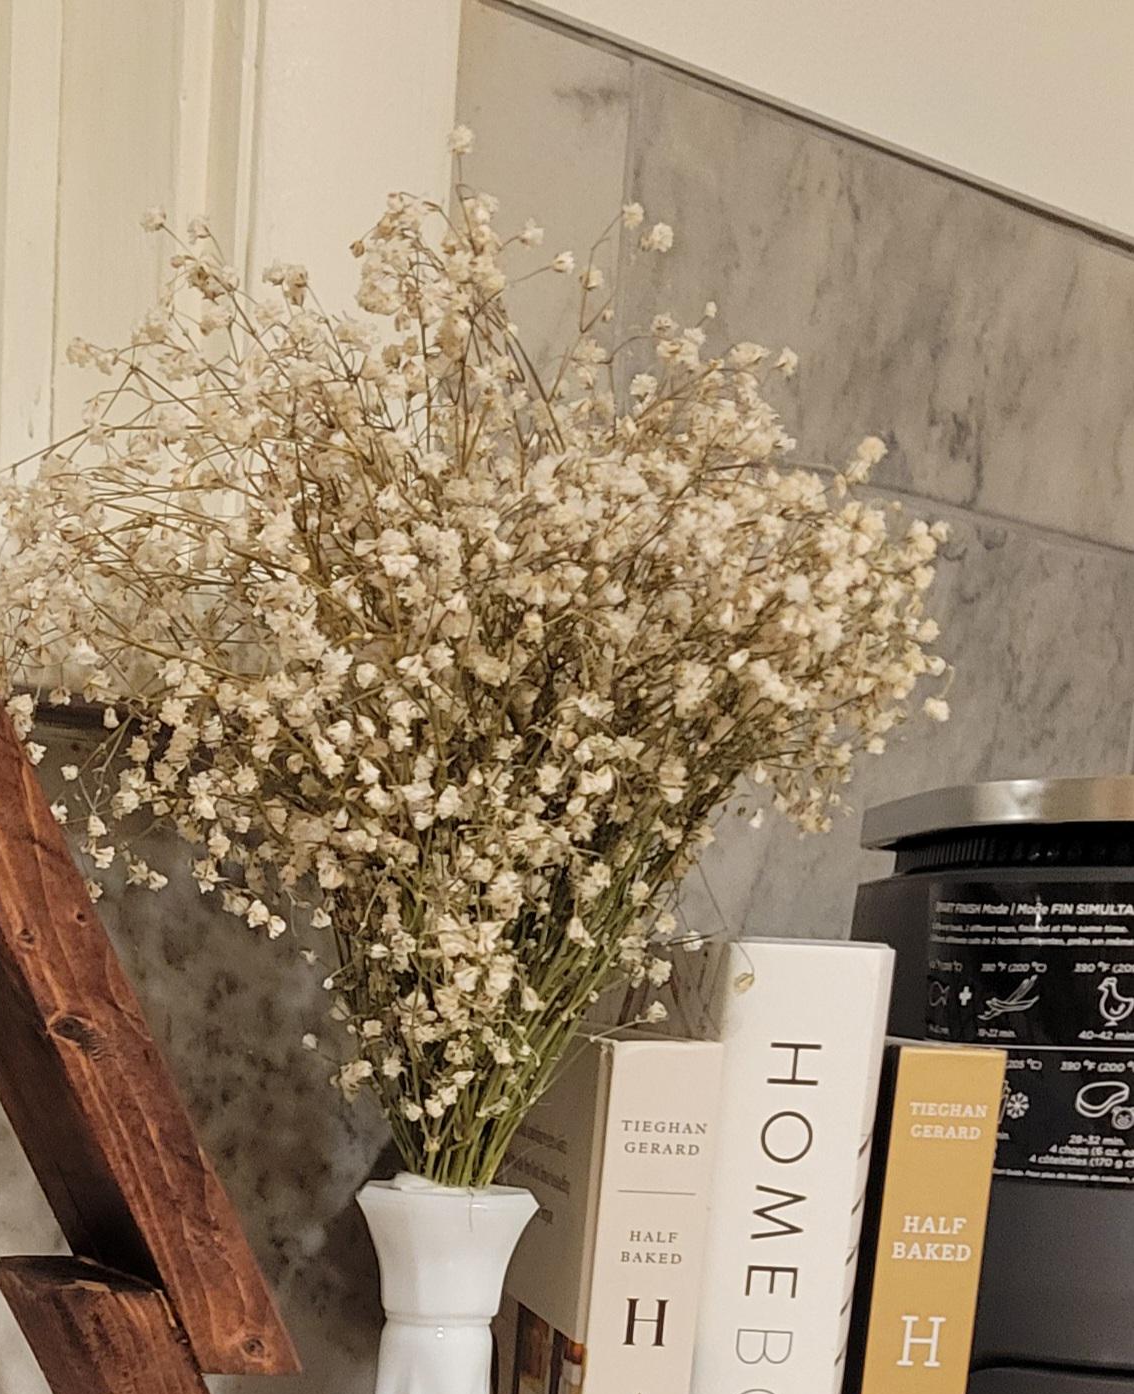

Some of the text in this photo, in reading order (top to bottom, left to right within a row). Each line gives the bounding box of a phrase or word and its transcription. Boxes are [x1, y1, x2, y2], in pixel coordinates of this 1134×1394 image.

[1050, 903, 1074, 915] FIN
[909, 1101, 988, 1119] TIEGHAN
[621, 1119, 708, 1135] TIEGHAN
[910, 1124, 982, 1141] GERARD
[624, 1141, 700, 1156] GERARD
[744, 1042, 822, 1300] HOME
[902, 1215, 968, 1235] HALF
[629, 1230, 679, 1244] HALF
[620, 1251, 683, 1265] BAKED
[891, 1241, 972, 1262] BAKED
